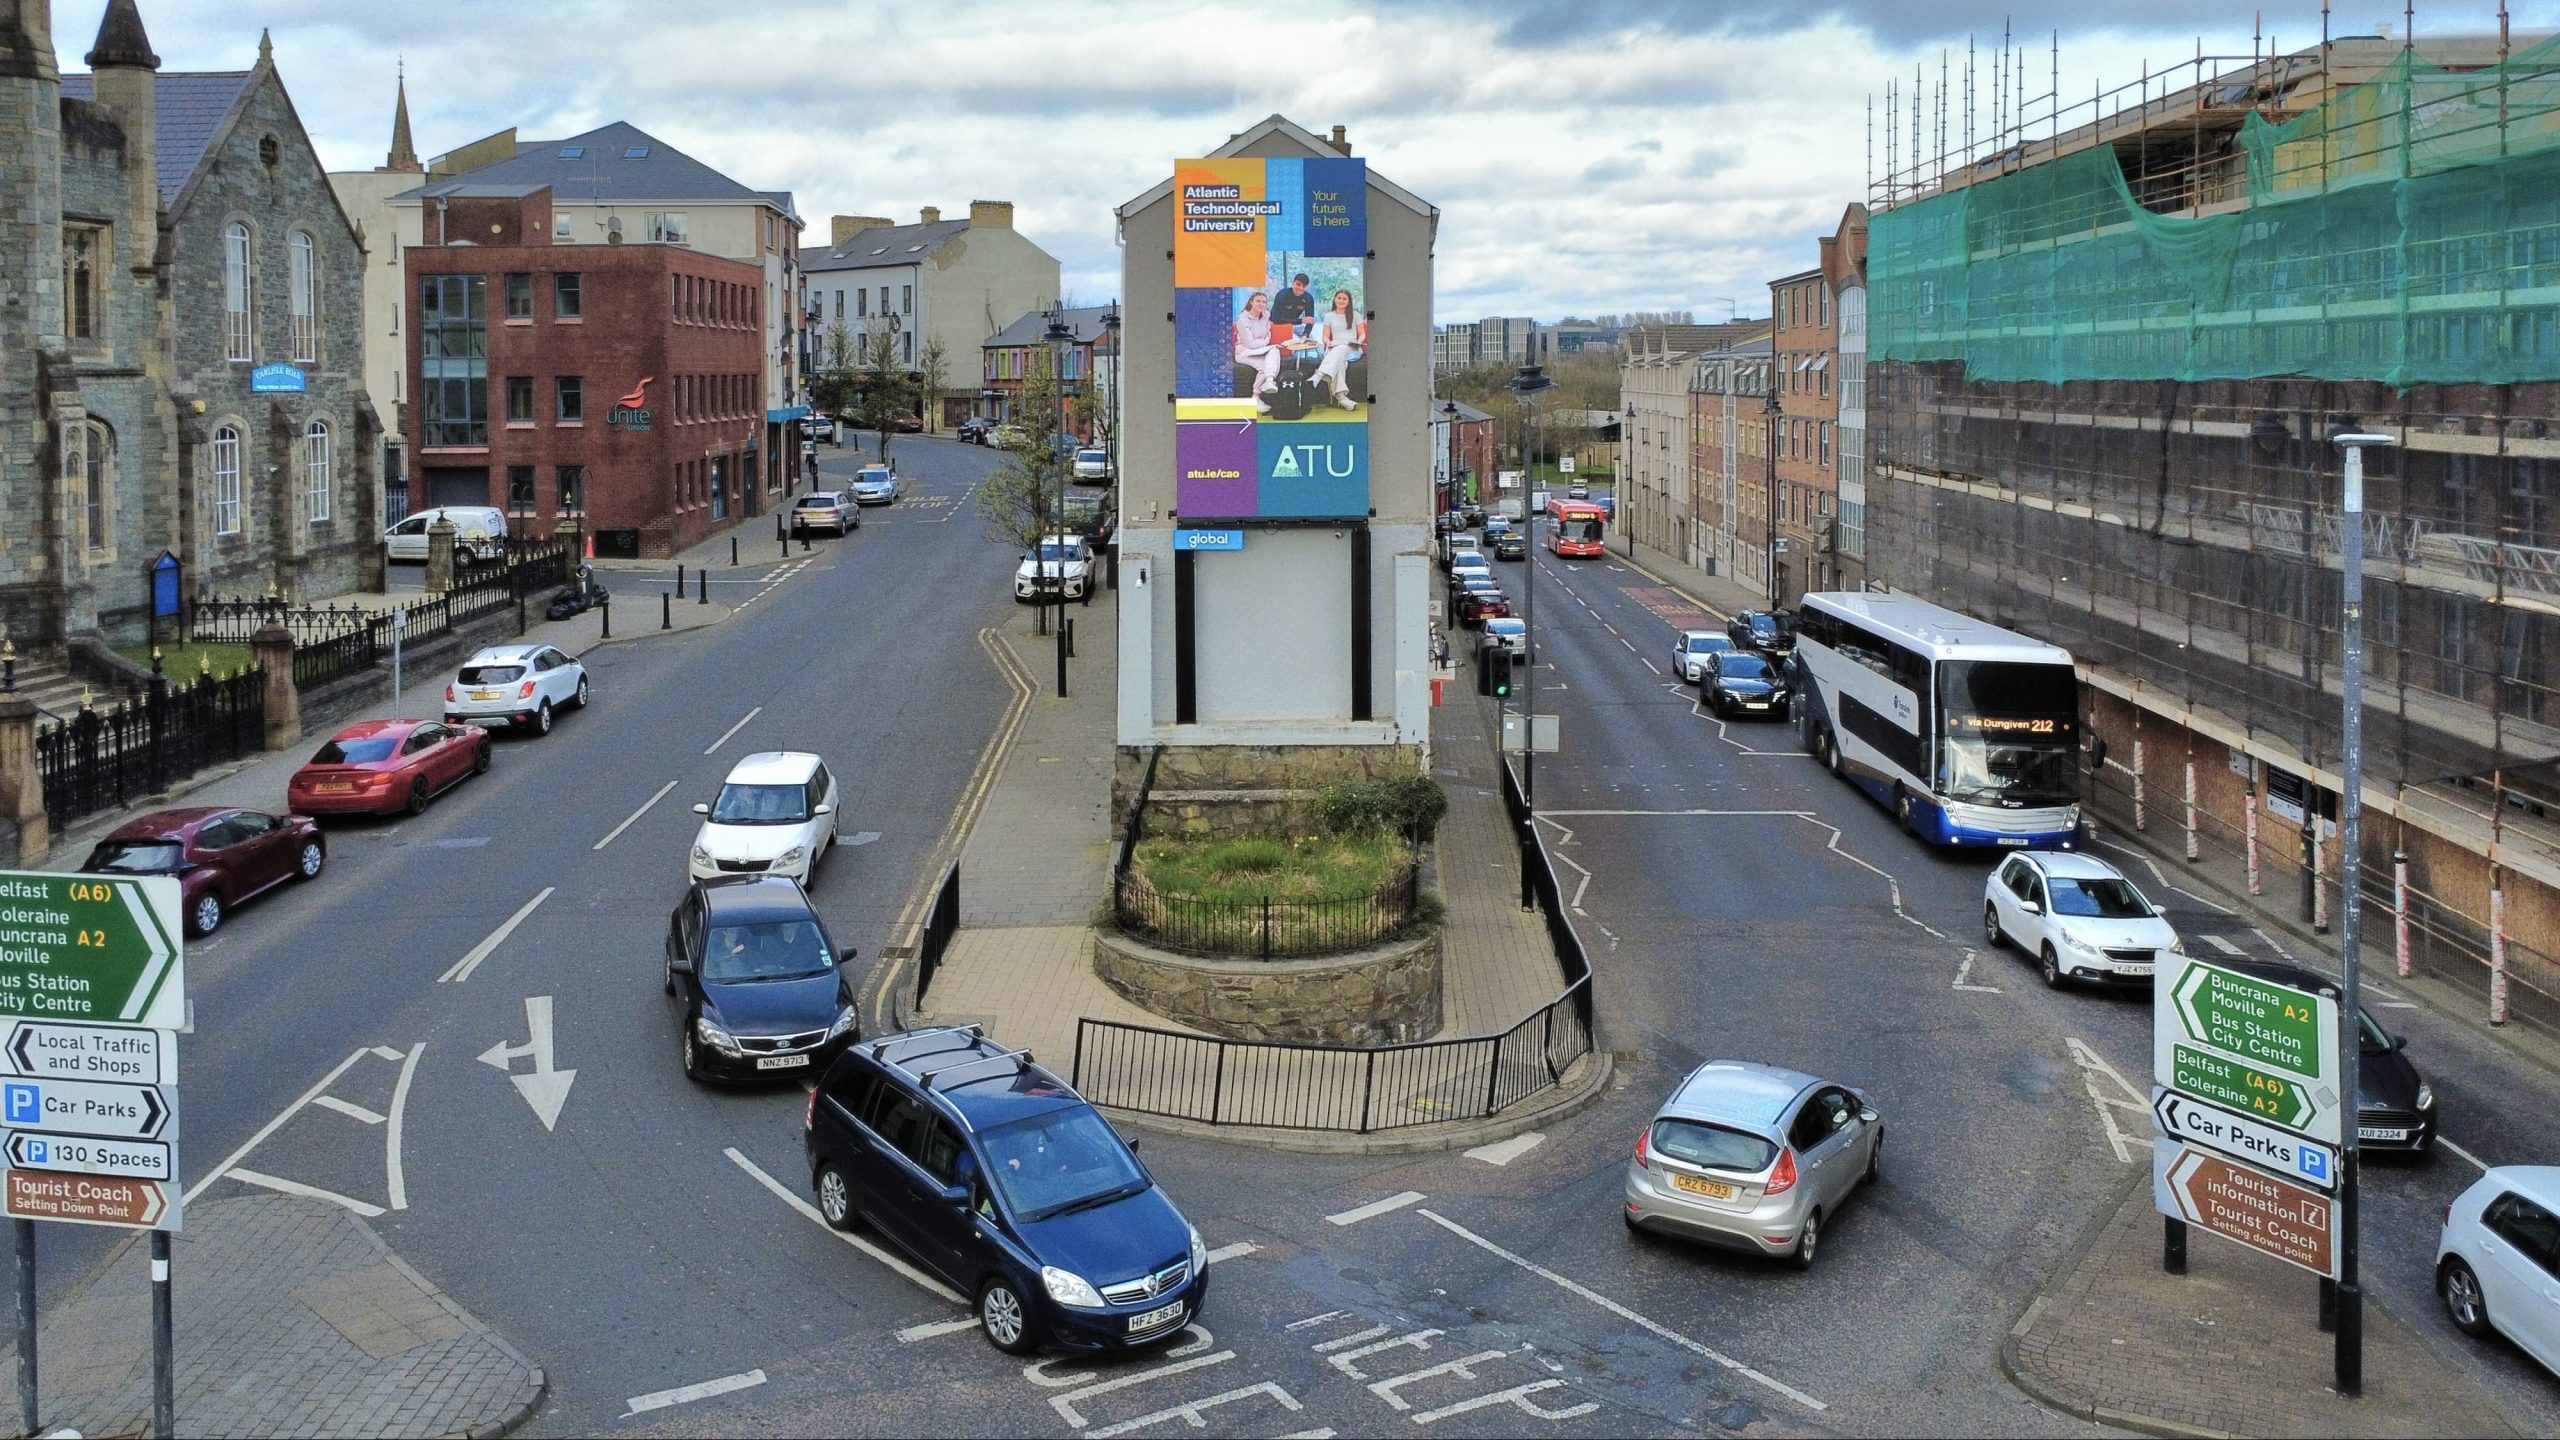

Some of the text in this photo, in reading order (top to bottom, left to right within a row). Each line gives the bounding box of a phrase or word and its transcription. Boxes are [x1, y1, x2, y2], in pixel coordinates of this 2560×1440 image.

[1185, 186, 1238, 198] Atlantic
[1312, 190, 1338, 201] Your
[1185, 202, 1280, 217] Technological
[1312, 203, 1345, 213] future
[1185, 219, 1254, 233] University
[1313, 216, 1350, 227] is here
[607, 408, 650, 424] unite
[1272, 444, 1354, 478] ATU
[1187, 468, 1240, 479] atu.ie/cao
[1188, 533, 1228, 548] global
[1984, 718, 2030, 730] Dungiven
[2031, 719, 2054, 733] 212
[0, 881, 49, 899] elfast
[0, 906, 70, 925] oleraine
[0, 930, 68, 945] uncrana
[0, 972, 90, 992] us Station
[2211, 974, 2280, 1006] Buncrana
[33, 993, 92, 1012] Centre
[2211, 990, 2266, 1018] Moville
[2212, 1010, 2301, 1050] Bus Station
[38, 1032, 151, 1054] Local Traffic
[2212, 1027, 2303, 1067] City Centre
[49, 1056, 141, 1076] and Shops
[763, 1056, 804, 1068] NNZ 9713
[2177, 1049, 2231, 1079] Belfast
[2177, 1070, 2248, 1105] Coleraine
[12, 1088, 137, 1118] P Car Parks
[2187, 1111, 2321, 1171] Car Parks P
[2360, 1128, 2401, 1138] XUI 2324
[31, 1141, 161, 1168] P 130 Spaces
[13, 1177, 132, 1202] Tourist Coach
[1678, 1176, 1729, 1196] CRZ 6793
[2226, 1168, 2280, 1199] Tourist
[16, 1197, 130, 1217] Setting Down Point
[2208, 1178, 2297, 1223] information
[2208, 1198, 2318, 1252] Tourist Coach
[2212, 1217, 2313, 1263] Setting down point
[1131, 1302, 1181, 1329] HFZ 3630
